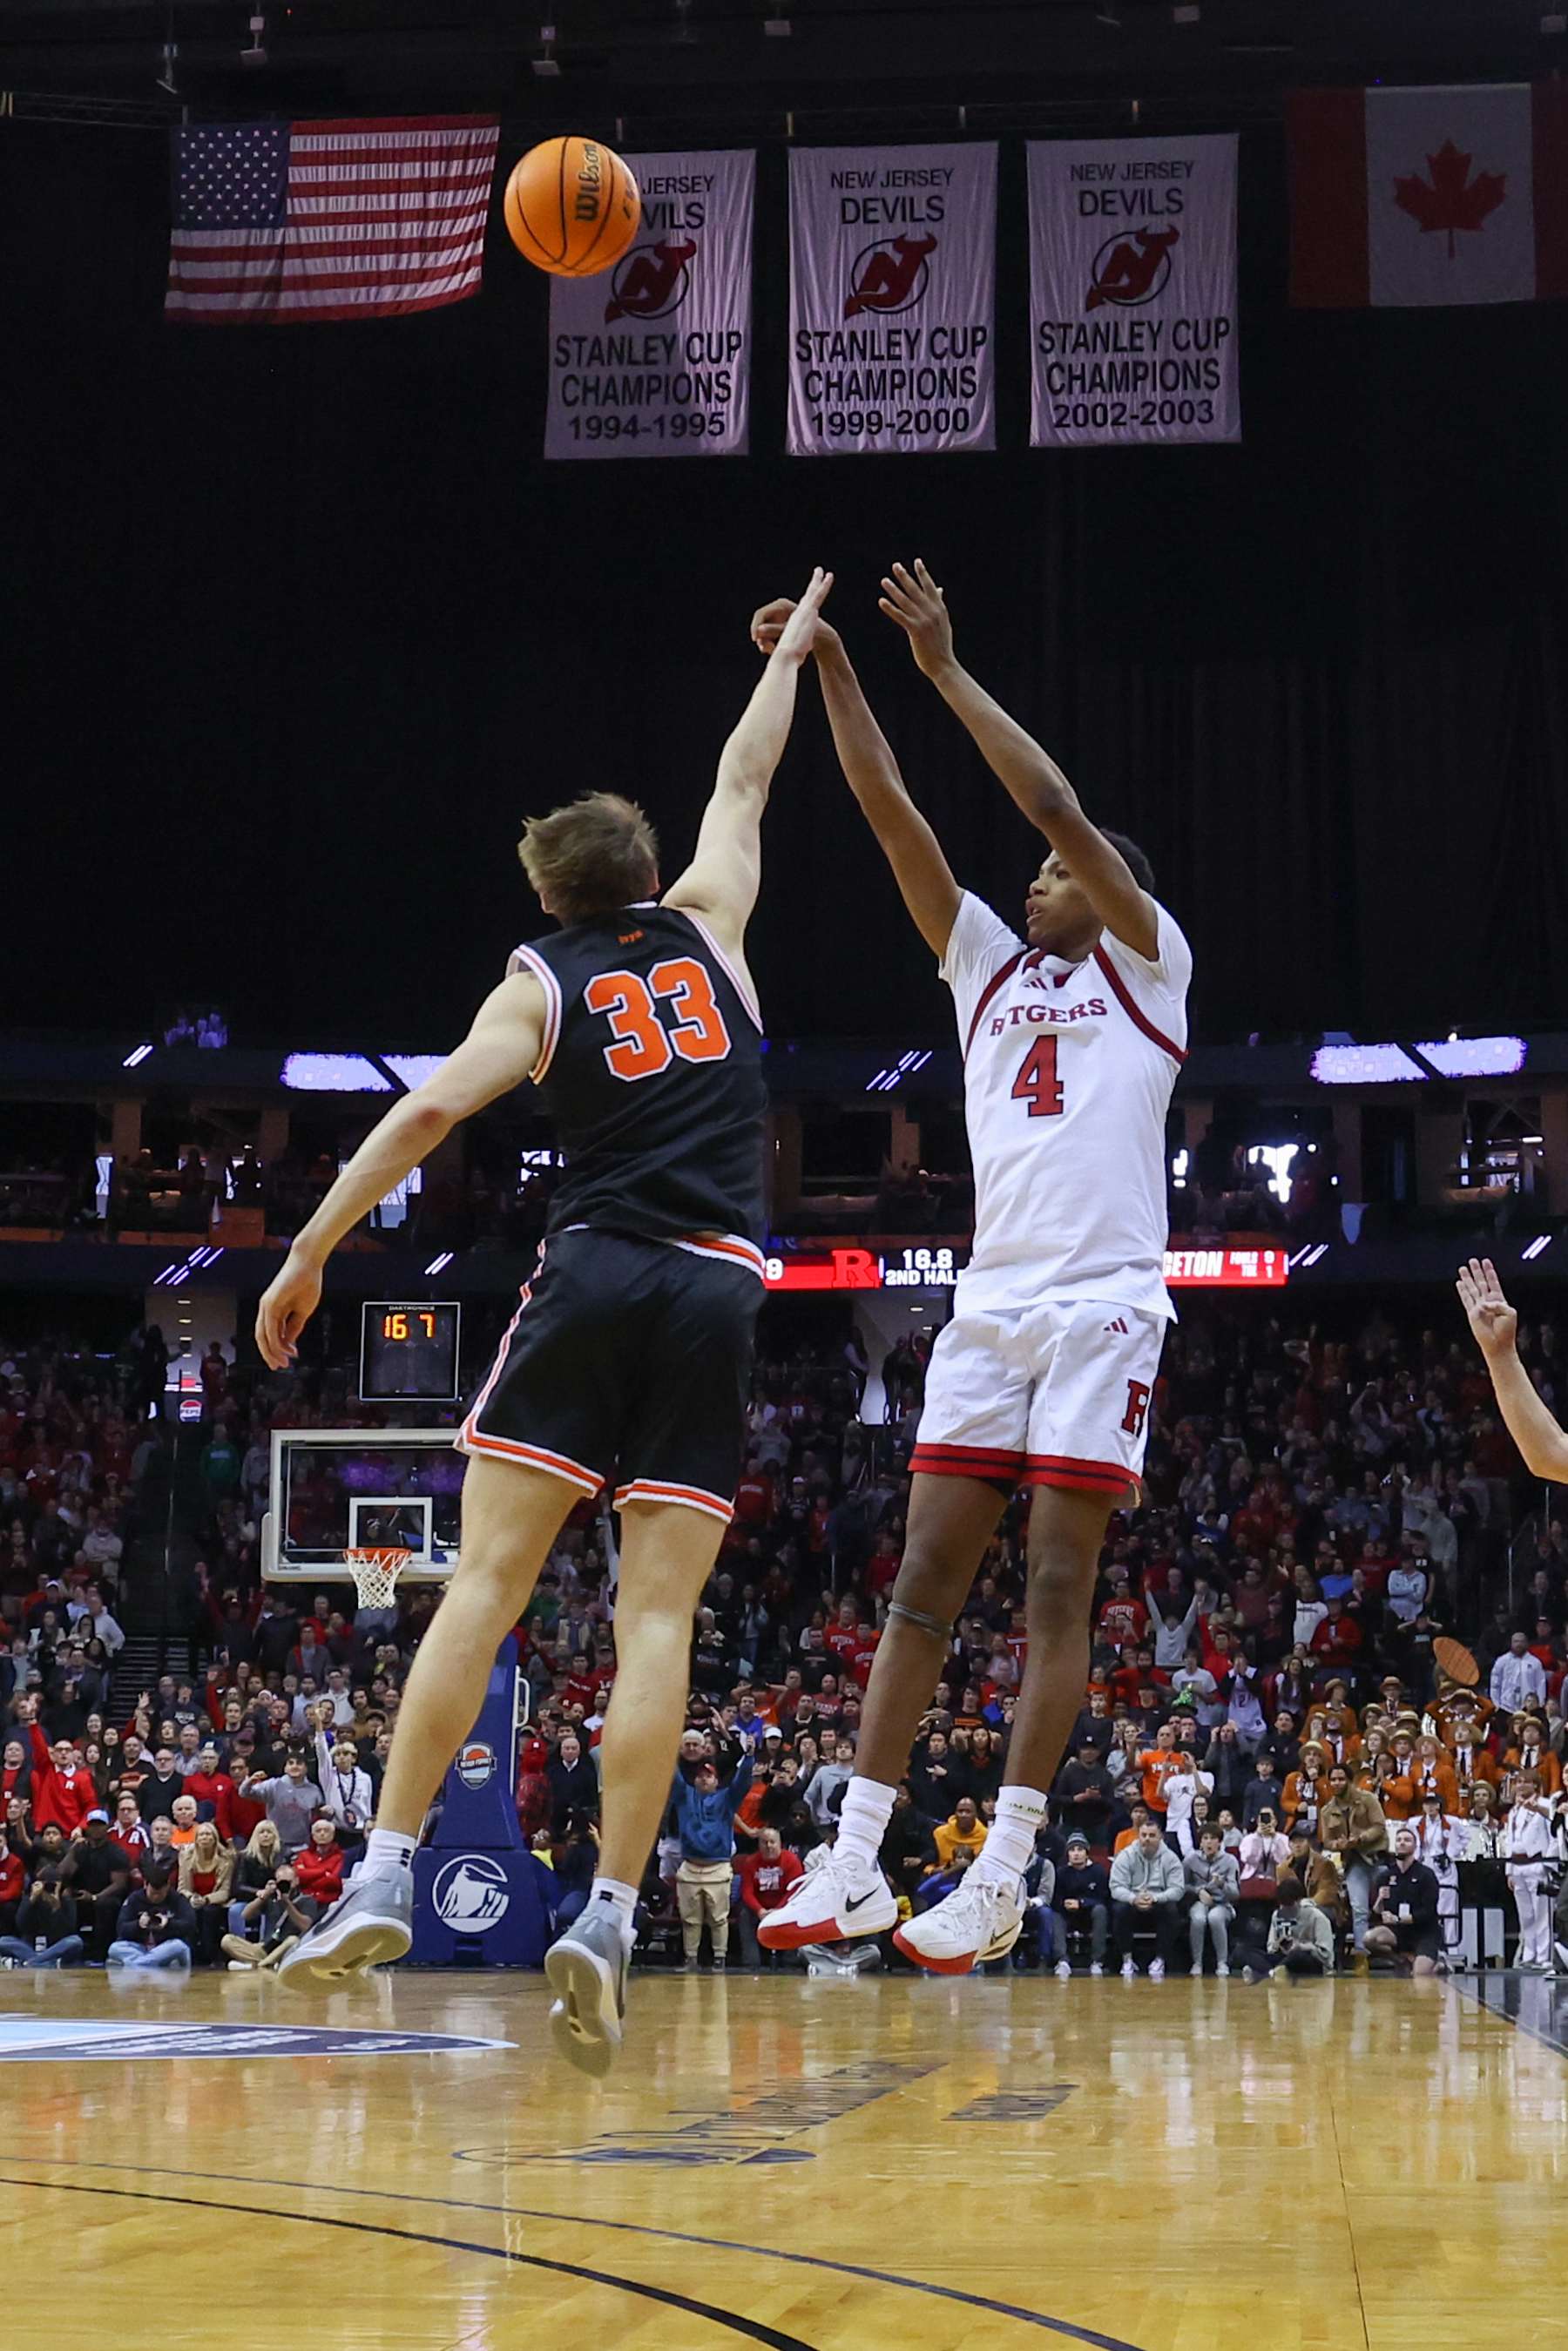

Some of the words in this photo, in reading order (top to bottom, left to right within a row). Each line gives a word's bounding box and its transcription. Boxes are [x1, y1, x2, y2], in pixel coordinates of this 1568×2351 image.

[574, 143, 600, 221] Wilson
[642, 175, 714, 195] JERSEY
[831, 171, 876, 189] NEW
[880, 168, 954, 187] JERSEY
[1071, 164, 1115, 181] NEW
[1121, 160, 1195, 180] JERSEY
[640, 202, 705, 231] VILS
[841, 195, 944, 224] DEVILS
[1079, 188, 1184, 216] DEVILS
[554, 334, 676, 368] STANLEY
[686, 330, 742, 364] CUP
[796, 328, 921, 362] STANLEY
[929, 326, 987, 360] CUP
[1039, 320, 1163, 355] STANLEY
[1173, 316, 1230, 351] CUP
[562, 369, 732, 406] CHAMPIONS
[805, 365, 977, 402] CHAMPIONS
[1046, 358, 1220, 395] CHAMPIONS
[570, 411, 725, 441] 1994-1995
[812, 408, 970, 436] 1999-2000
[1054, 399, 1214, 429] 2002-2003
[583, 956, 732, 1082] 33
[990, 998, 1107, 1036] RTGERS
[1011, 1034, 1064, 1118] 4
[831, 1249, 880, 1288] R
[902, 1248, 953, 1270] 16.8
[1162, 1250, 1224, 1278] CETON
[885, 1269, 921, 1286] 2ND
